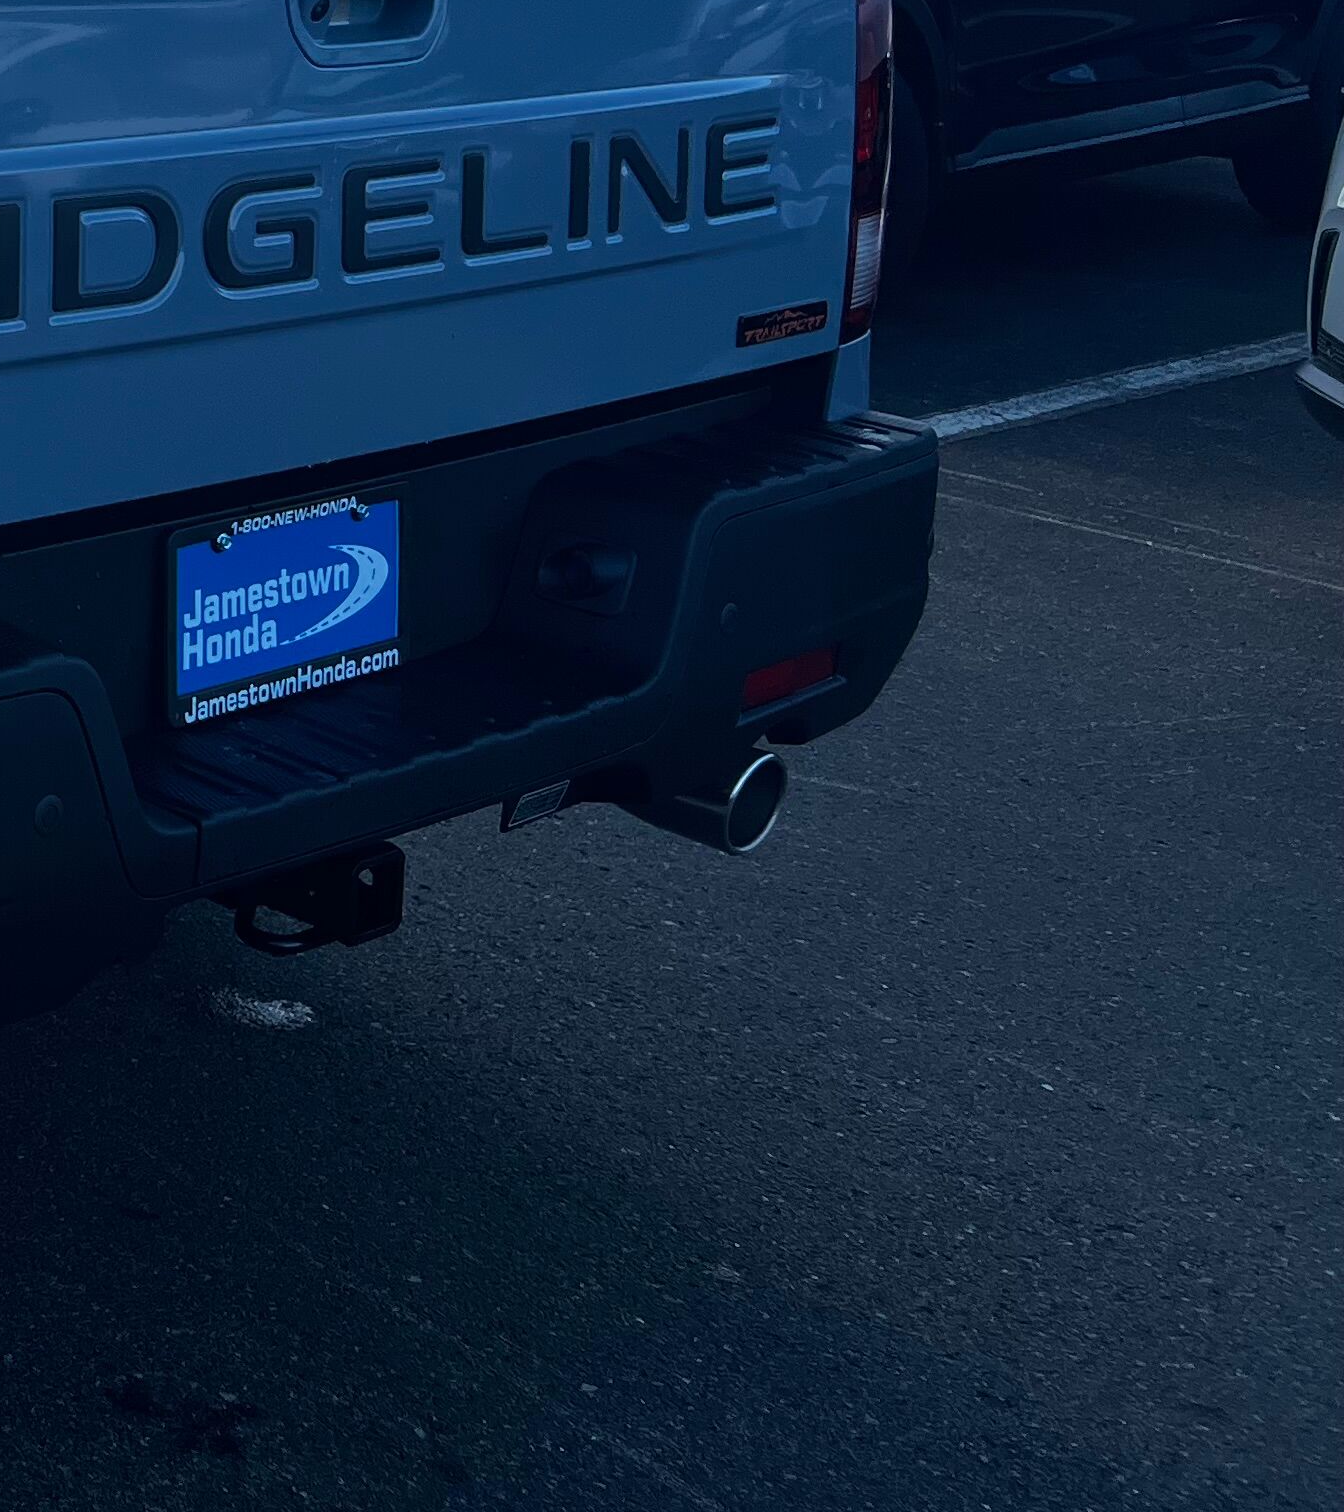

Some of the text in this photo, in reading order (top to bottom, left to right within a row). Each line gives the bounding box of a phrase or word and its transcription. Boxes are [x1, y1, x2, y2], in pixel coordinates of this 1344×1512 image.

[744, 314, 825, 343] TRAILSPORT
[230, 495, 358, 536] 1-800-NEW-HONDA
[183, 561, 350, 629] Jamestown
[182, 613, 278, 671] Honda
[184, 647, 400, 725] JamestownHonda.com
